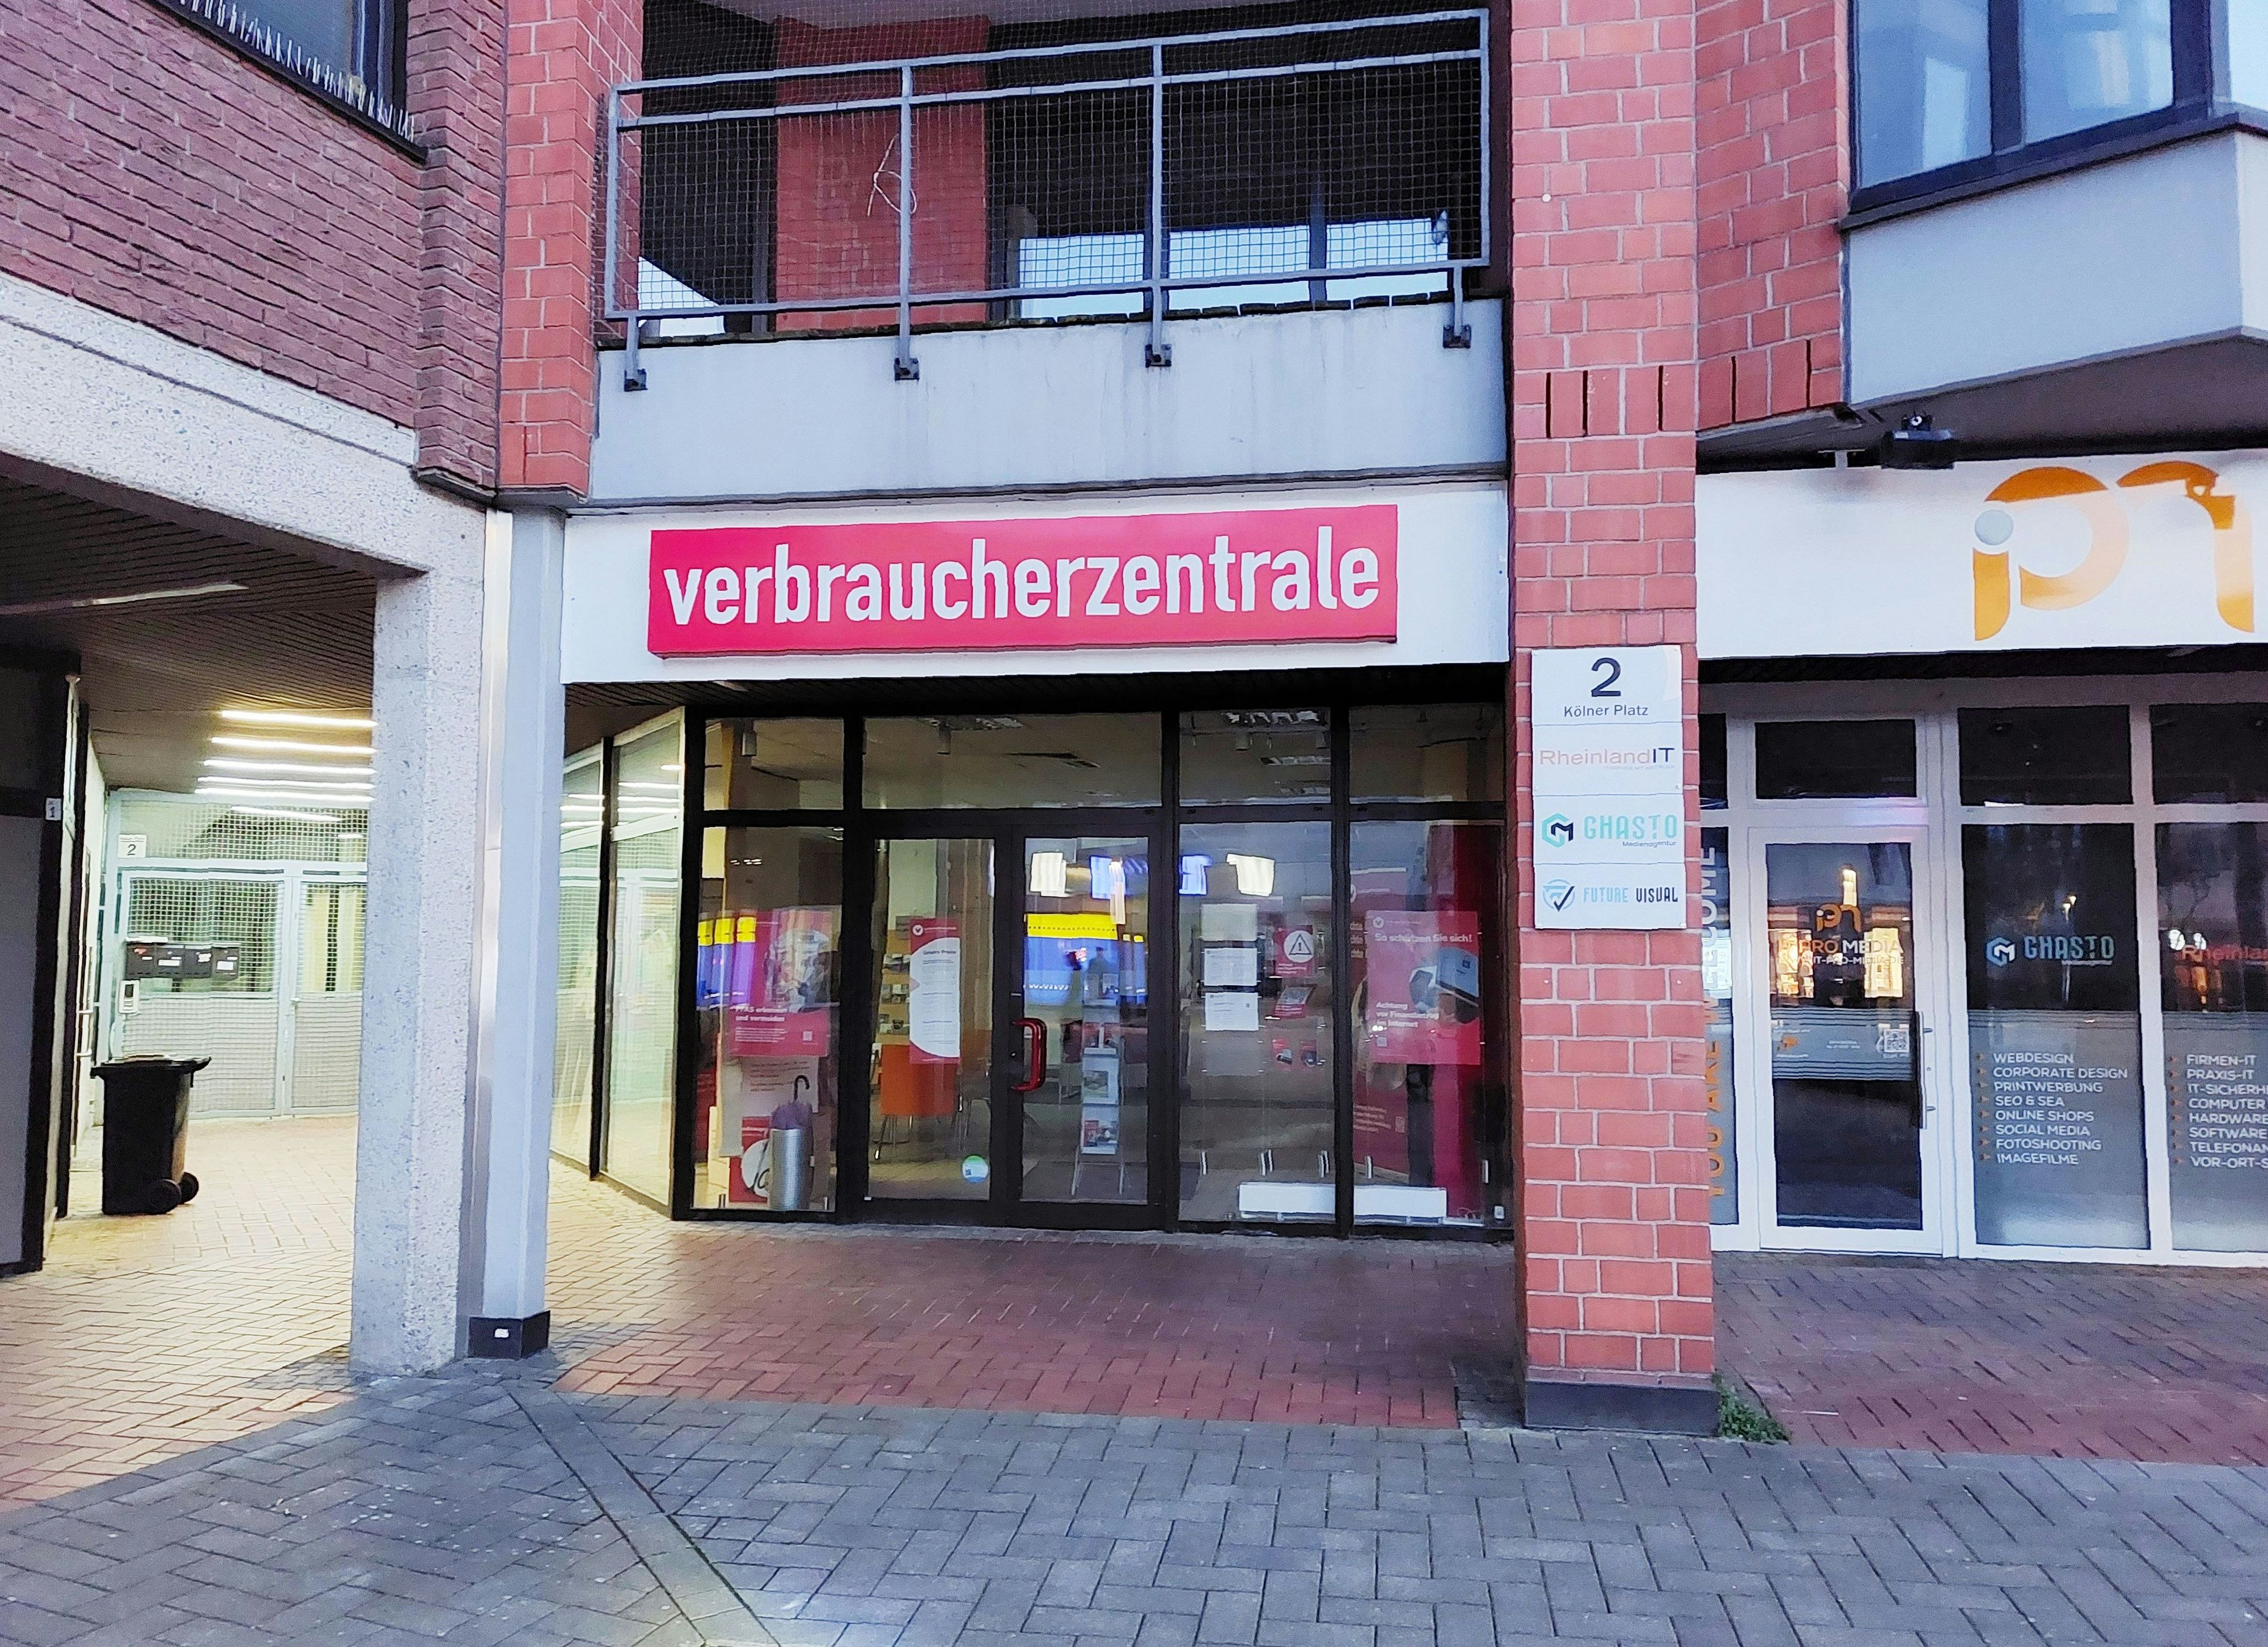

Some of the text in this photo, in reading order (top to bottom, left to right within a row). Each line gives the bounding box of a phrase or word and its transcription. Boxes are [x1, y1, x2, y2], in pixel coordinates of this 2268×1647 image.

[664, 526, 1379, 625] verbraucherzentrale
[1591, 657, 1621, 697] 2
[1564, 705, 1648, 718] Kölner Platz
[1539, 747, 1675, 765] RheinlandIT
[1584, 814, 1677, 840] GHASTO
[127, 844, 136, 856] 2
[1583, 887, 1678, 903] FUTURE VISUAL
[1374, 933, 1387, 942] So
[1433, 934, 1448, 942] Sie
[1799, 940, 1904, 954] PRO MEDIA
[2024, 936, 2114, 959] GHASTO
[1993, 1052, 2074, 1064] WEBDESIGN
[2186, 1054, 2257, 1066] FIRMEN-IT
[1993, 1066, 2127, 1079] CORPORATE DESIGN
[2187, 1069, 2254, 1081] PRAXIS-IT
[1994, 1081, 2103, 1093] PRINTWERBUNG
[1995, 1095, 2065, 1107] SEO & SEA
[2189, 1098, 2266, 1110] COMPUTER
[1995, 1110, 2094, 1122] ONLINE SHOPS
[2189, 1112, 2268, 1124] HARDWARE
[1995, 1124, 2091, 1136] SOCIAL MEDIA
[2189, 1127, 2268, 1140] SOFTWARE
[1996, 1138, 2102, 1150] FOTOSHOOTING
[1997, 1153, 2079, 1165] IMAGEFILME
